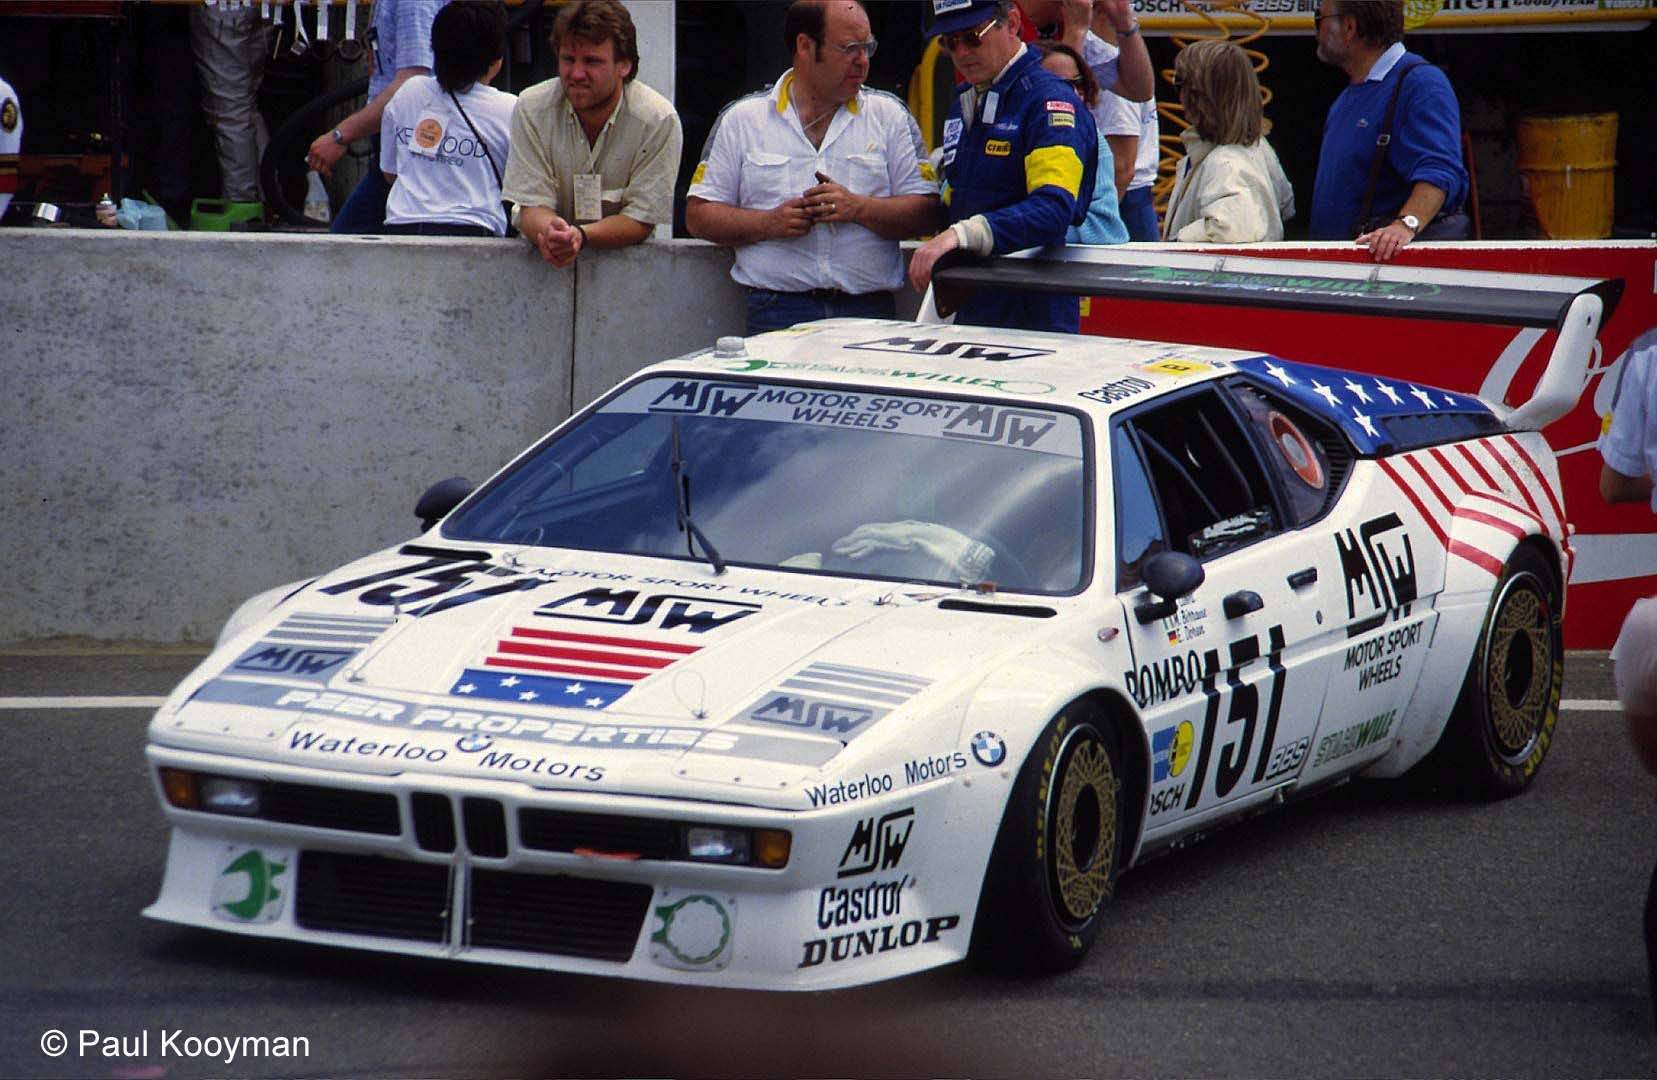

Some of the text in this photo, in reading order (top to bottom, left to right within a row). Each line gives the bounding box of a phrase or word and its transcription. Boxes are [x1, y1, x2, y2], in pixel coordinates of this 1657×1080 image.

[1133, 0, 1181, 12] OSCH
[396, 127, 486, 157] KEOOD
[843, 336, 1056, 362] MSW
[648, 380, 1057, 447] MSW MOTOR SPORT MSW
[1077, 375, 1156, 405] Castrol
[791, 407, 902, 430] WHEELS
[528, 568, 853, 607] MOTOR SPORT WHEELS
[1333, 511, 1418, 638] MSW
[533, 587, 763, 634] MSW
[233, 646, 356, 674] MSW
[1343, 620, 1424, 671] MOTOR SPORT
[1358, 655, 1402, 692] WHEELS
[276, 689, 741, 751] PEER PROPERTIES
[751, 696, 873, 733] MSW
[1184, 624, 1288, 813] 151
[288, 730, 608, 782] Waterloo Motors
[803, 751, 968, 808] Waterloo Motors
[837, 806, 915, 880] MSW
[817, 873, 918, 930] Castrol
[797, 914, 961, 969] DUNLOP
